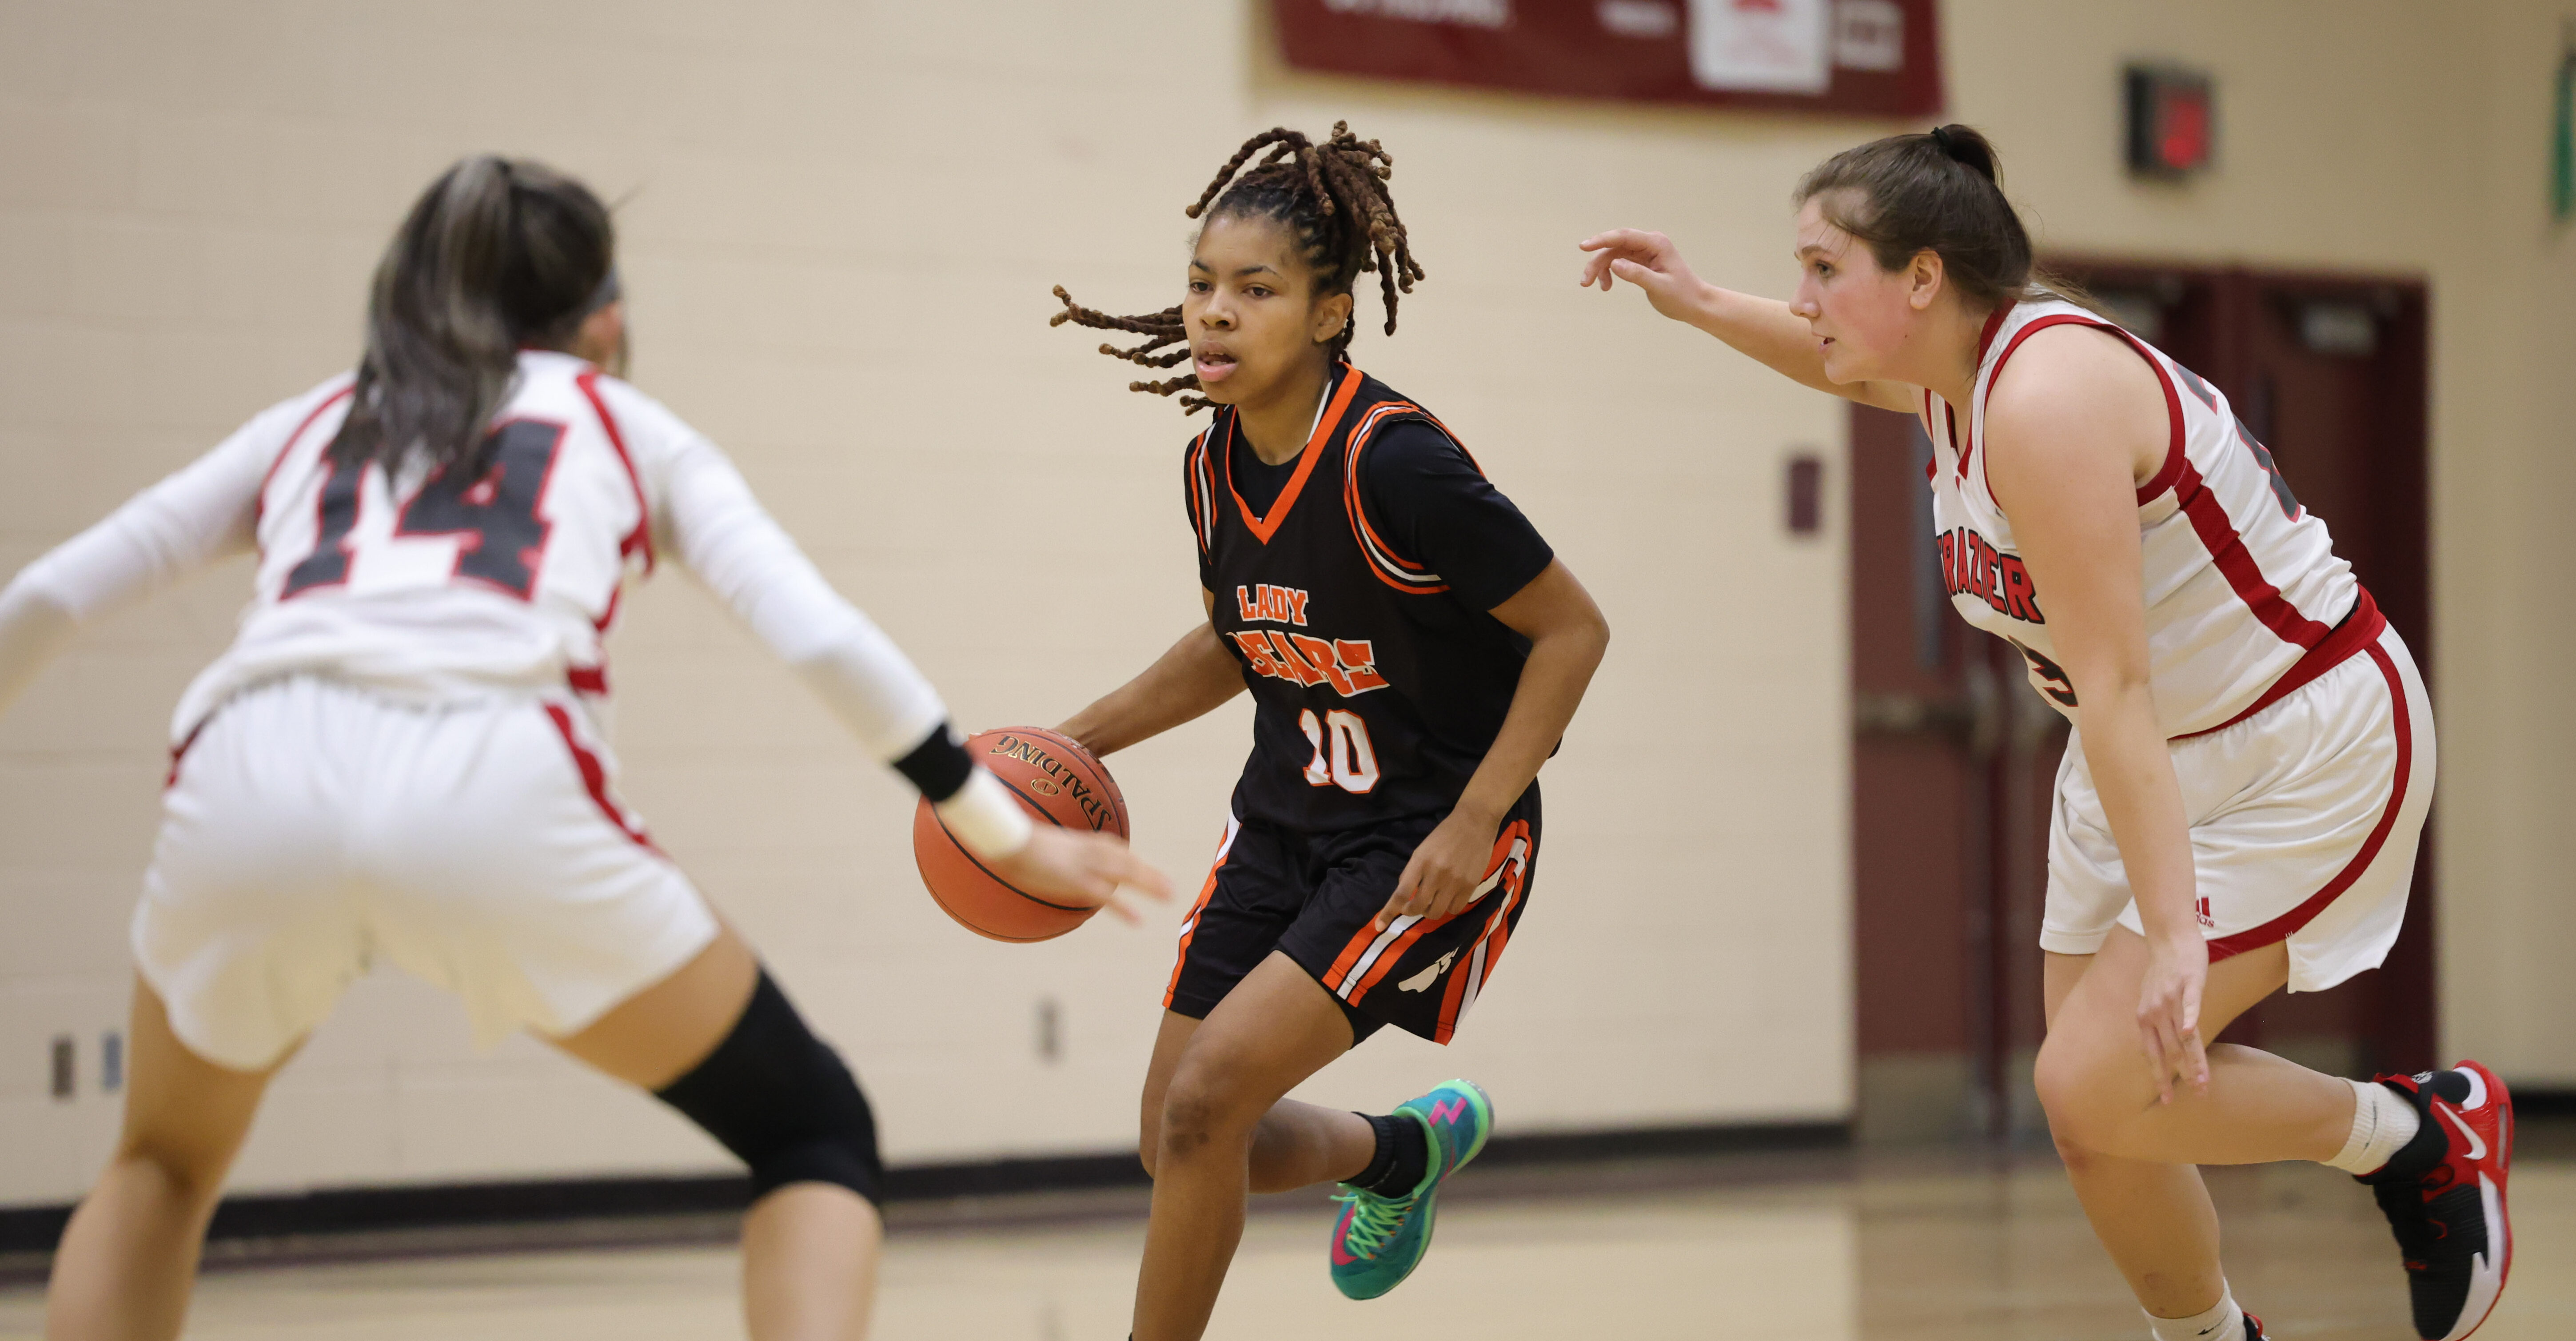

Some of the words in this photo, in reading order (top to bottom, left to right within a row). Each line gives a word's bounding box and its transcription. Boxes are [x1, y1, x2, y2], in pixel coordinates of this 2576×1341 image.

[278, 417, 569, 603] 14
[1237, 583, 1309, 627] LADY
[1936, 526, 2045, 624] RAZIER
[989, 735, 1112, 833] SPALDING
[1298, 708, 1380, 794] 10
